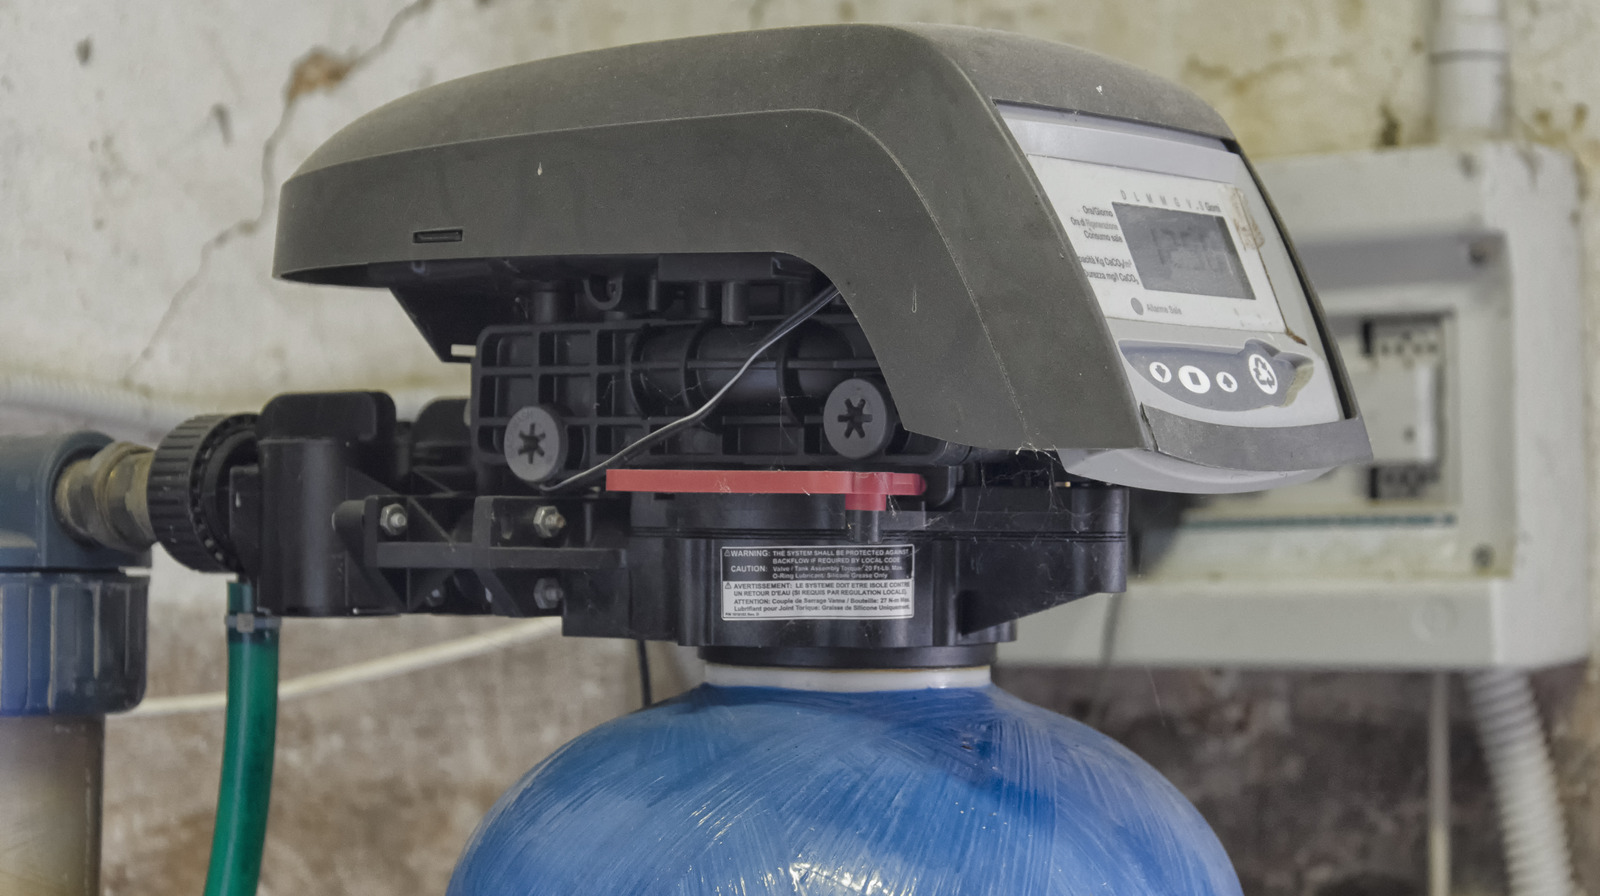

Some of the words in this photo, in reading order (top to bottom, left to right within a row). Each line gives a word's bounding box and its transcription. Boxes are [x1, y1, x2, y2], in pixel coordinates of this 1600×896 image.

[1120, 189, 1127, 201] D
[1133, 192, 1140, 202] L
[1082, 205, 1113, 217] Ora/Giorno
[1070, 217, 1081, 226] Ora
[1080, 218, 1086, 227] di
[1083, 230, 1111, 241] Consumo
[1110, 234, 1124, 243] sale
[1095, 255, 1106, 267] Kg
[1147, 303, 1169, 314] Allarme
[1168, 305, 1183, 315] Sale
[730, 549, 771, 557] WARNING:
[730, 565, 768, 573] CAUTION:
